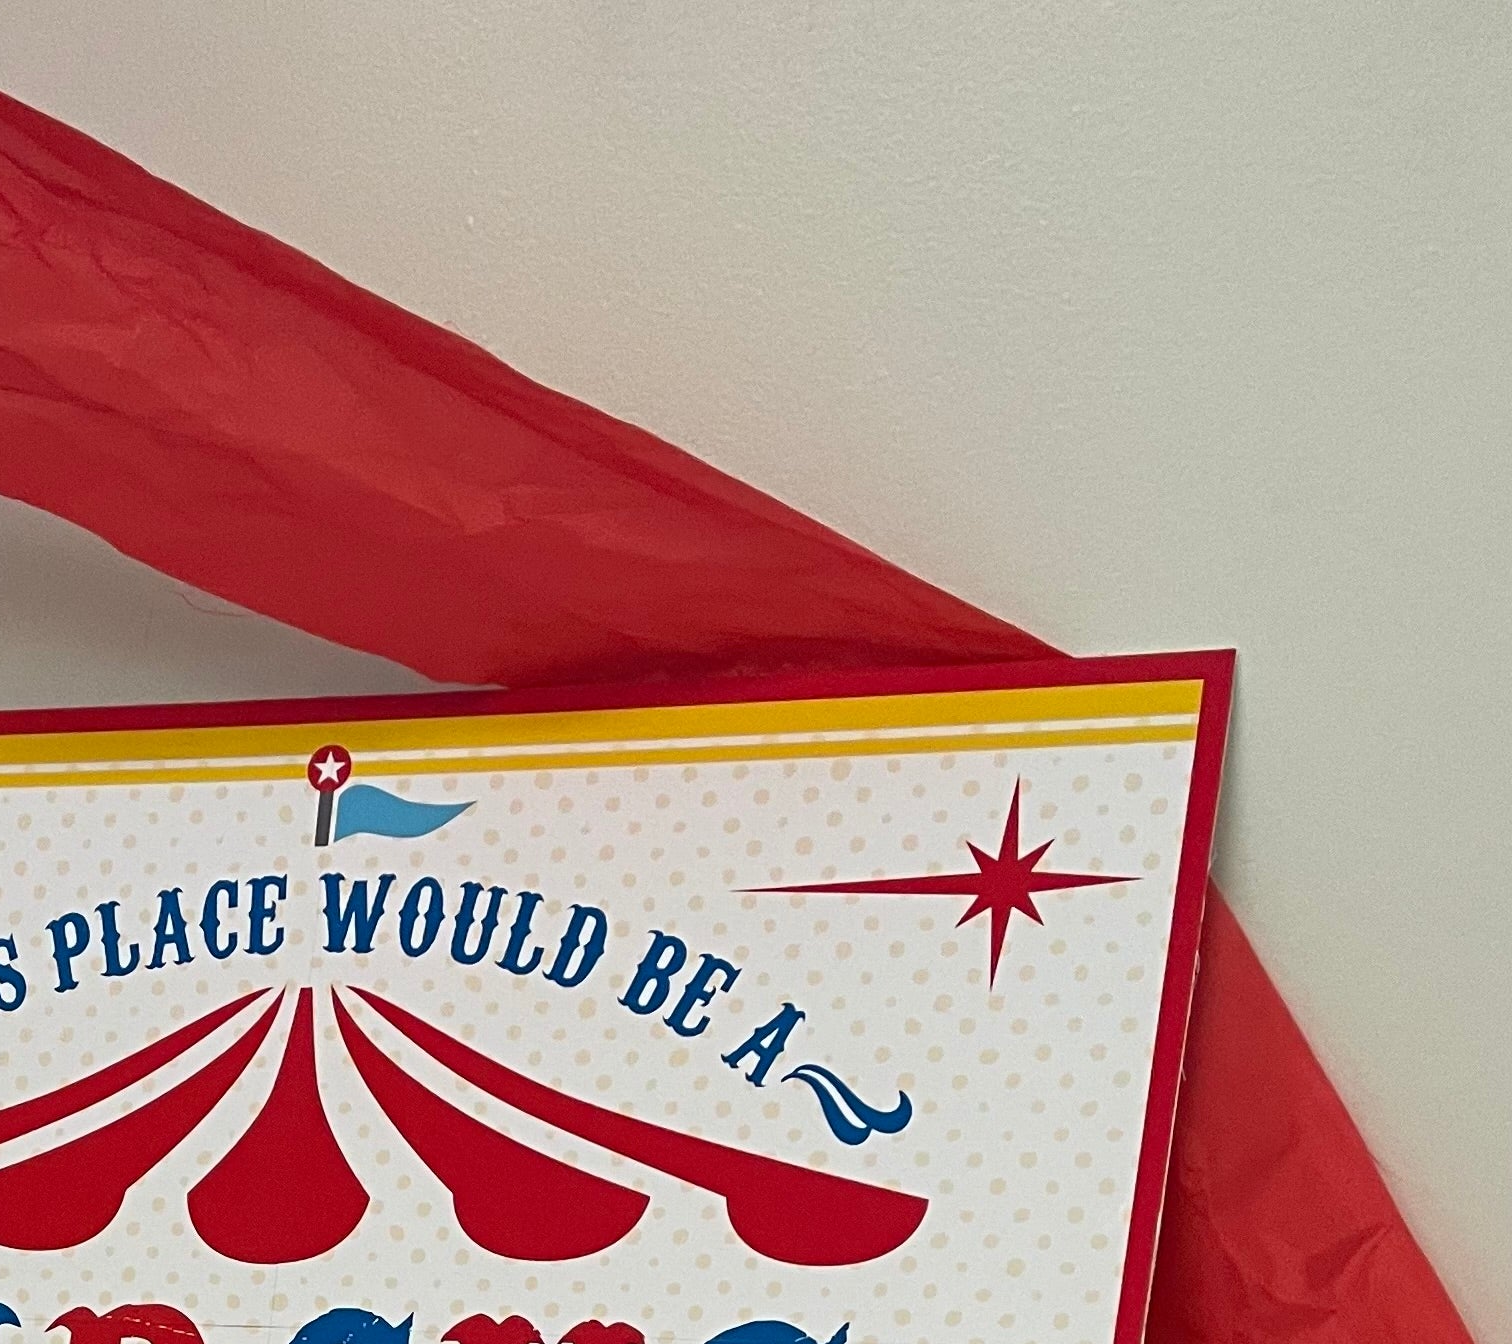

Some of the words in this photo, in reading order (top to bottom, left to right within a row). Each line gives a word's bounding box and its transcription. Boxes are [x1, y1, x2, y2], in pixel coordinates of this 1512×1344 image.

[45, 874, 288, 993] PLACE
[319, 872, 608, 988] WOULD
[617, 930, 742, 1038] BE
[721, 1002, 806, 1088] A
